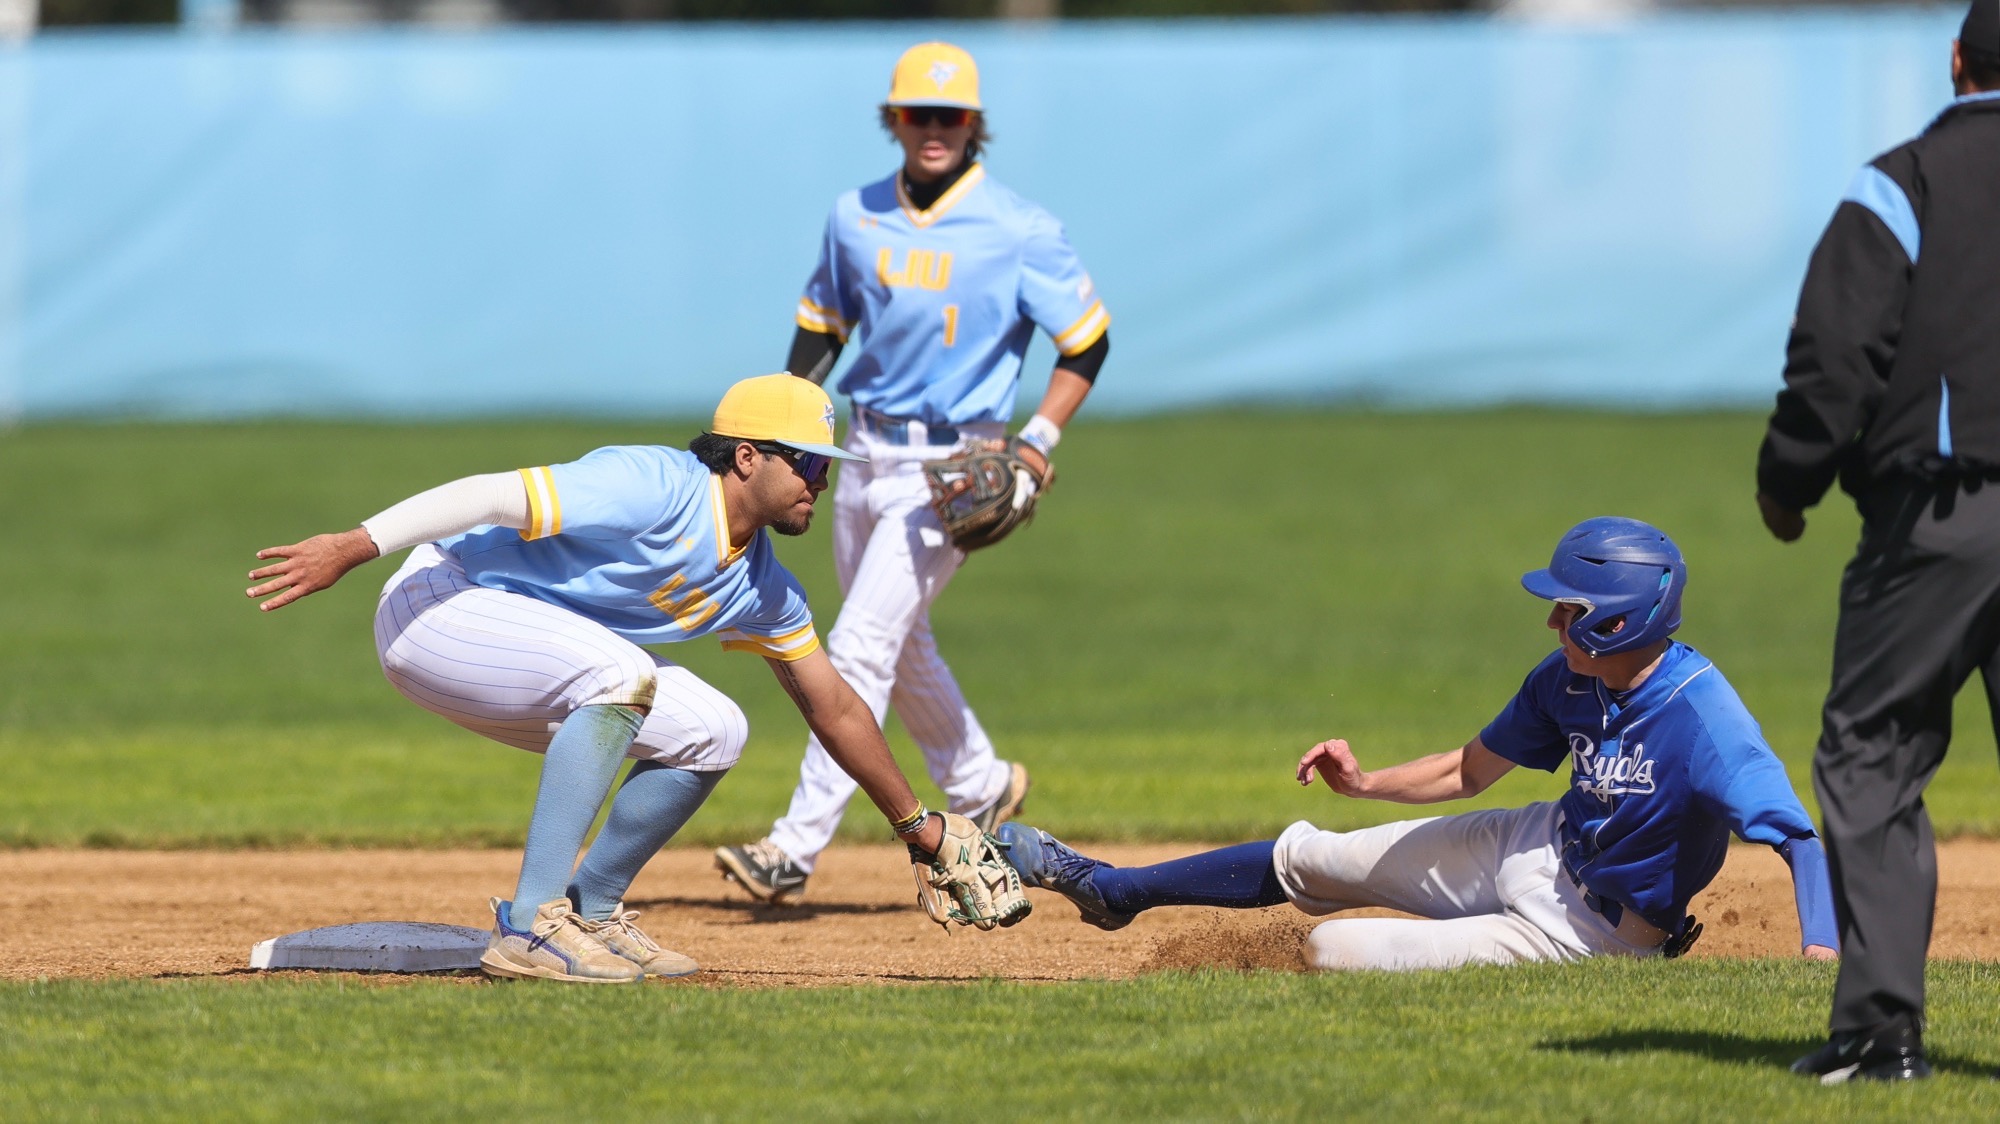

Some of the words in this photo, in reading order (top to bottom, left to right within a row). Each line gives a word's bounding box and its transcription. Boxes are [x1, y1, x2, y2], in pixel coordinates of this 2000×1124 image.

[876, 247, 954, 291] LIU
[943, 305, 958, 347] 1
[646, 572, 720, 632] LIU
[1569, 732, 1655, 803] Ryals
